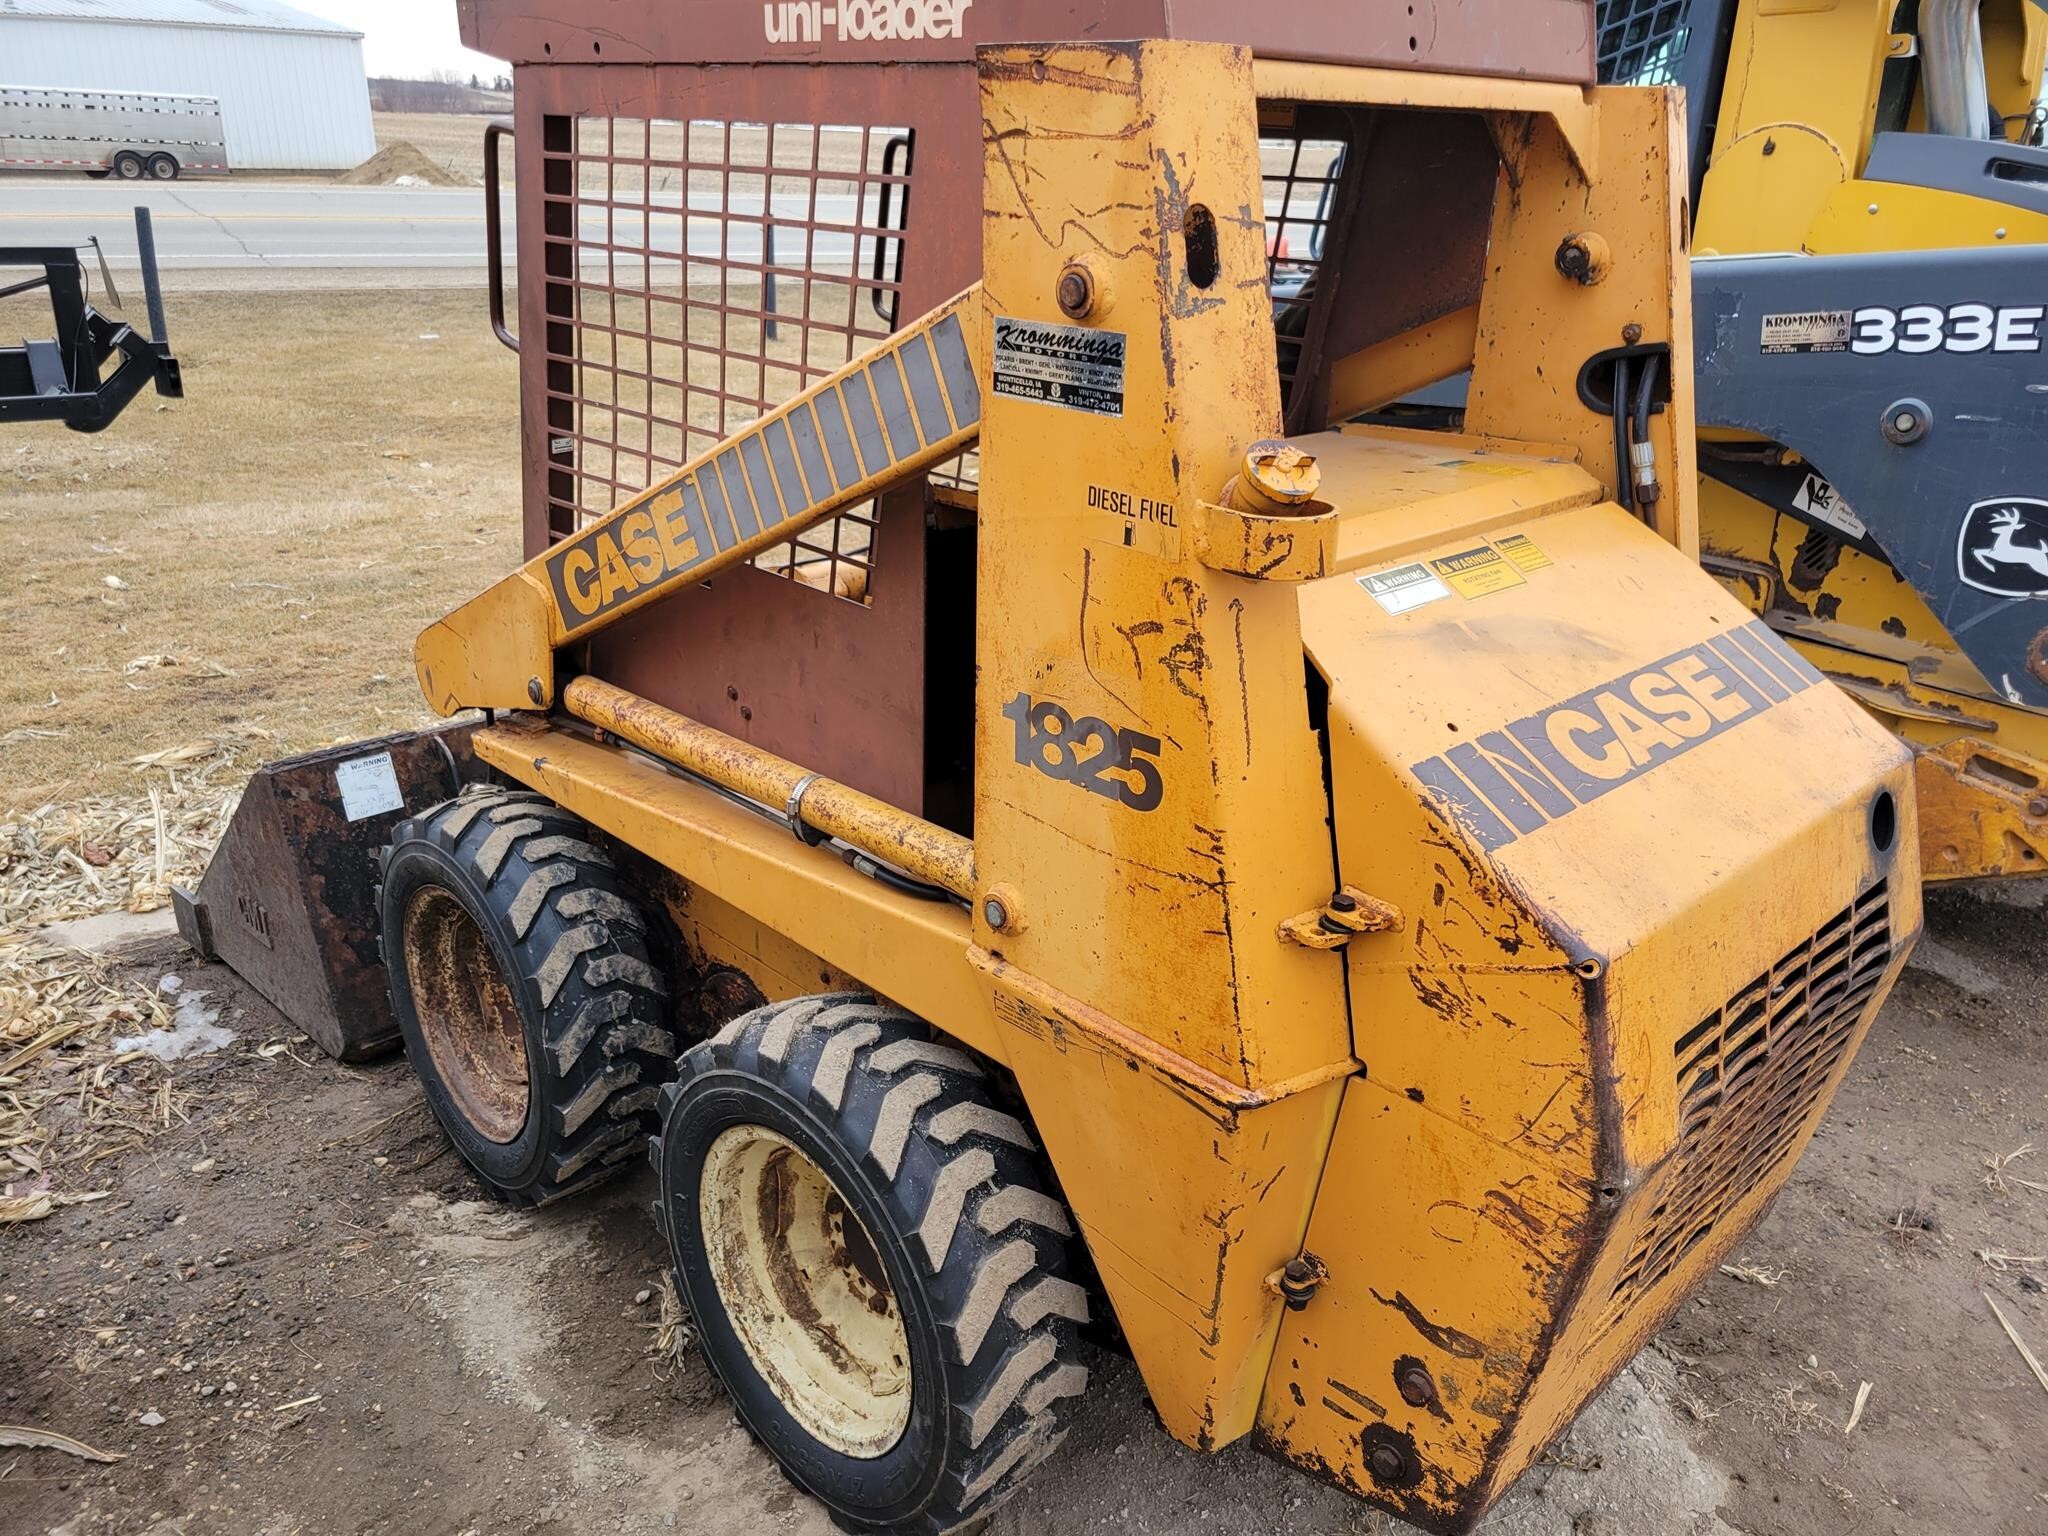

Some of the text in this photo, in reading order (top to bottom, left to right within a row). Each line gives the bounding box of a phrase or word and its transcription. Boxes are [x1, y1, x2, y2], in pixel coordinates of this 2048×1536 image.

[764, 0, 972, 43] uni-loader
[1766, 313, 1845, 328] KROMMINGA
[1851, 303, 2044, 354] 333E
[997, 325, 1123, 362] Kromminga
[1021, 346, 1088, 361] MOTORS
[1088, 485, 1178, 528] DIESEL FUEL
[563, 488, 700, 616] CASE
[1448, 550, 1499, 572] WARNING
[1383, 569, 1427, 589] WARNING
[1545, 654, 1752, 780] CASE
[350, 756, 388, 770] WARNING
[1002, 691, 1164, 812] 1825
